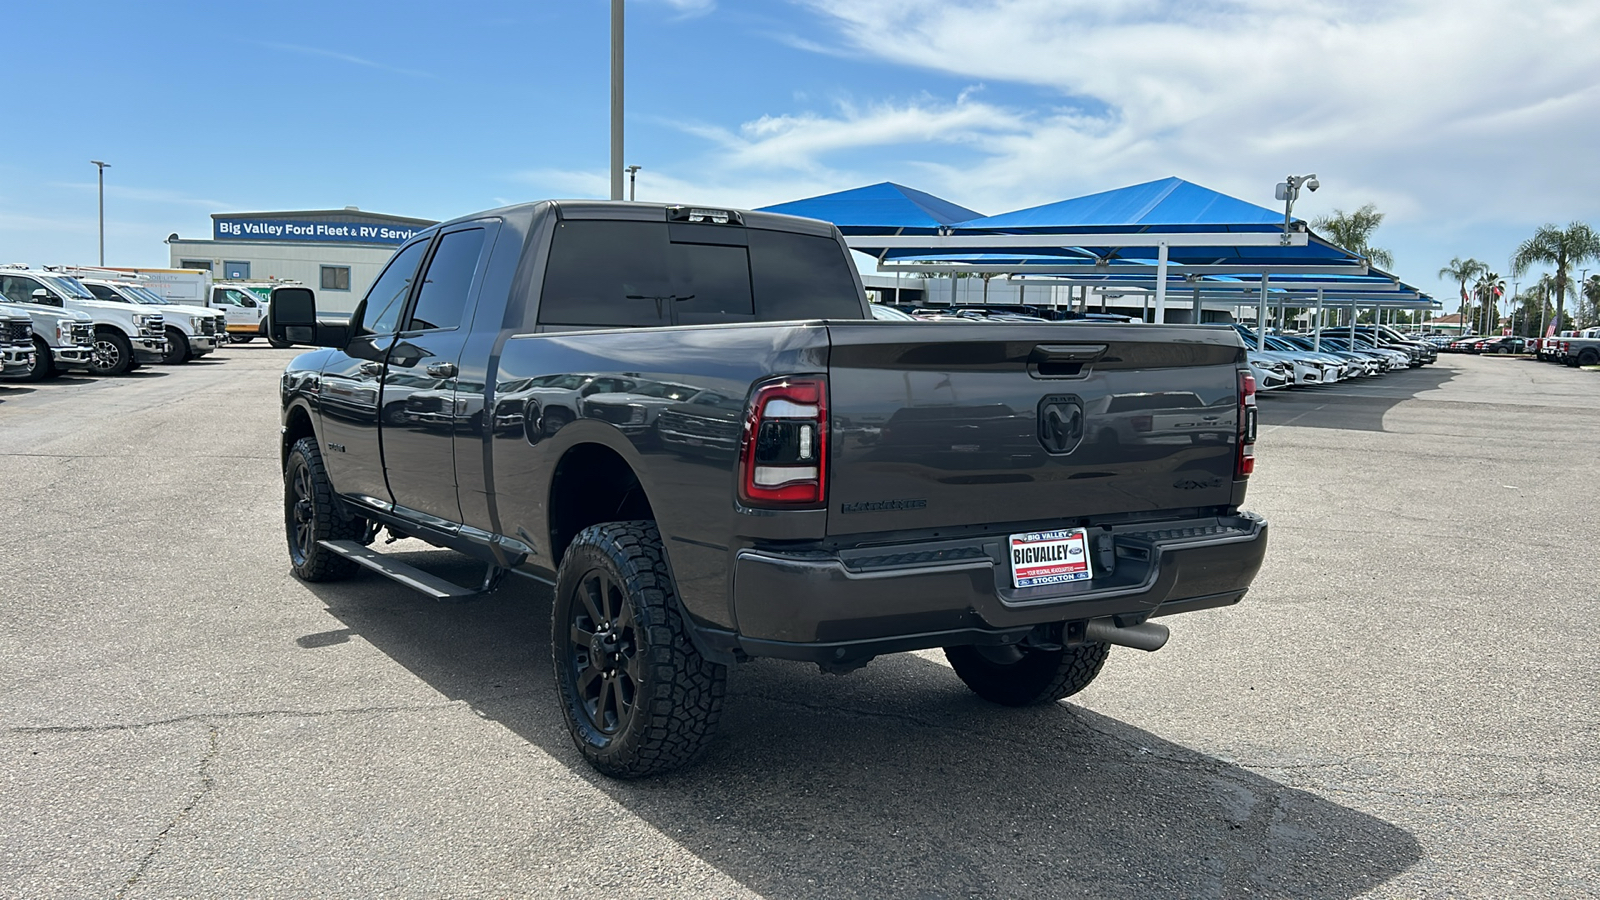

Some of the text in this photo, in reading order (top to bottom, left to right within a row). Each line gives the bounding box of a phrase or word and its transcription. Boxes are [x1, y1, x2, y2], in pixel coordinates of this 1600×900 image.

[219, 222, 241, 235] Big
[243, 223, 283, 236] Valley
[285, 224, 314, 235] Ford
[316, 225, 349, 236] Fleet
[350, 228, 357, 237] &
[360, 227, 378, 238] RV
[1027, 531, 1067, 541] BIG VALLEY
[1013, 544, 1069, 564] BIGVALLEY
[1032, 574, 1074, 584] STOCKTON
